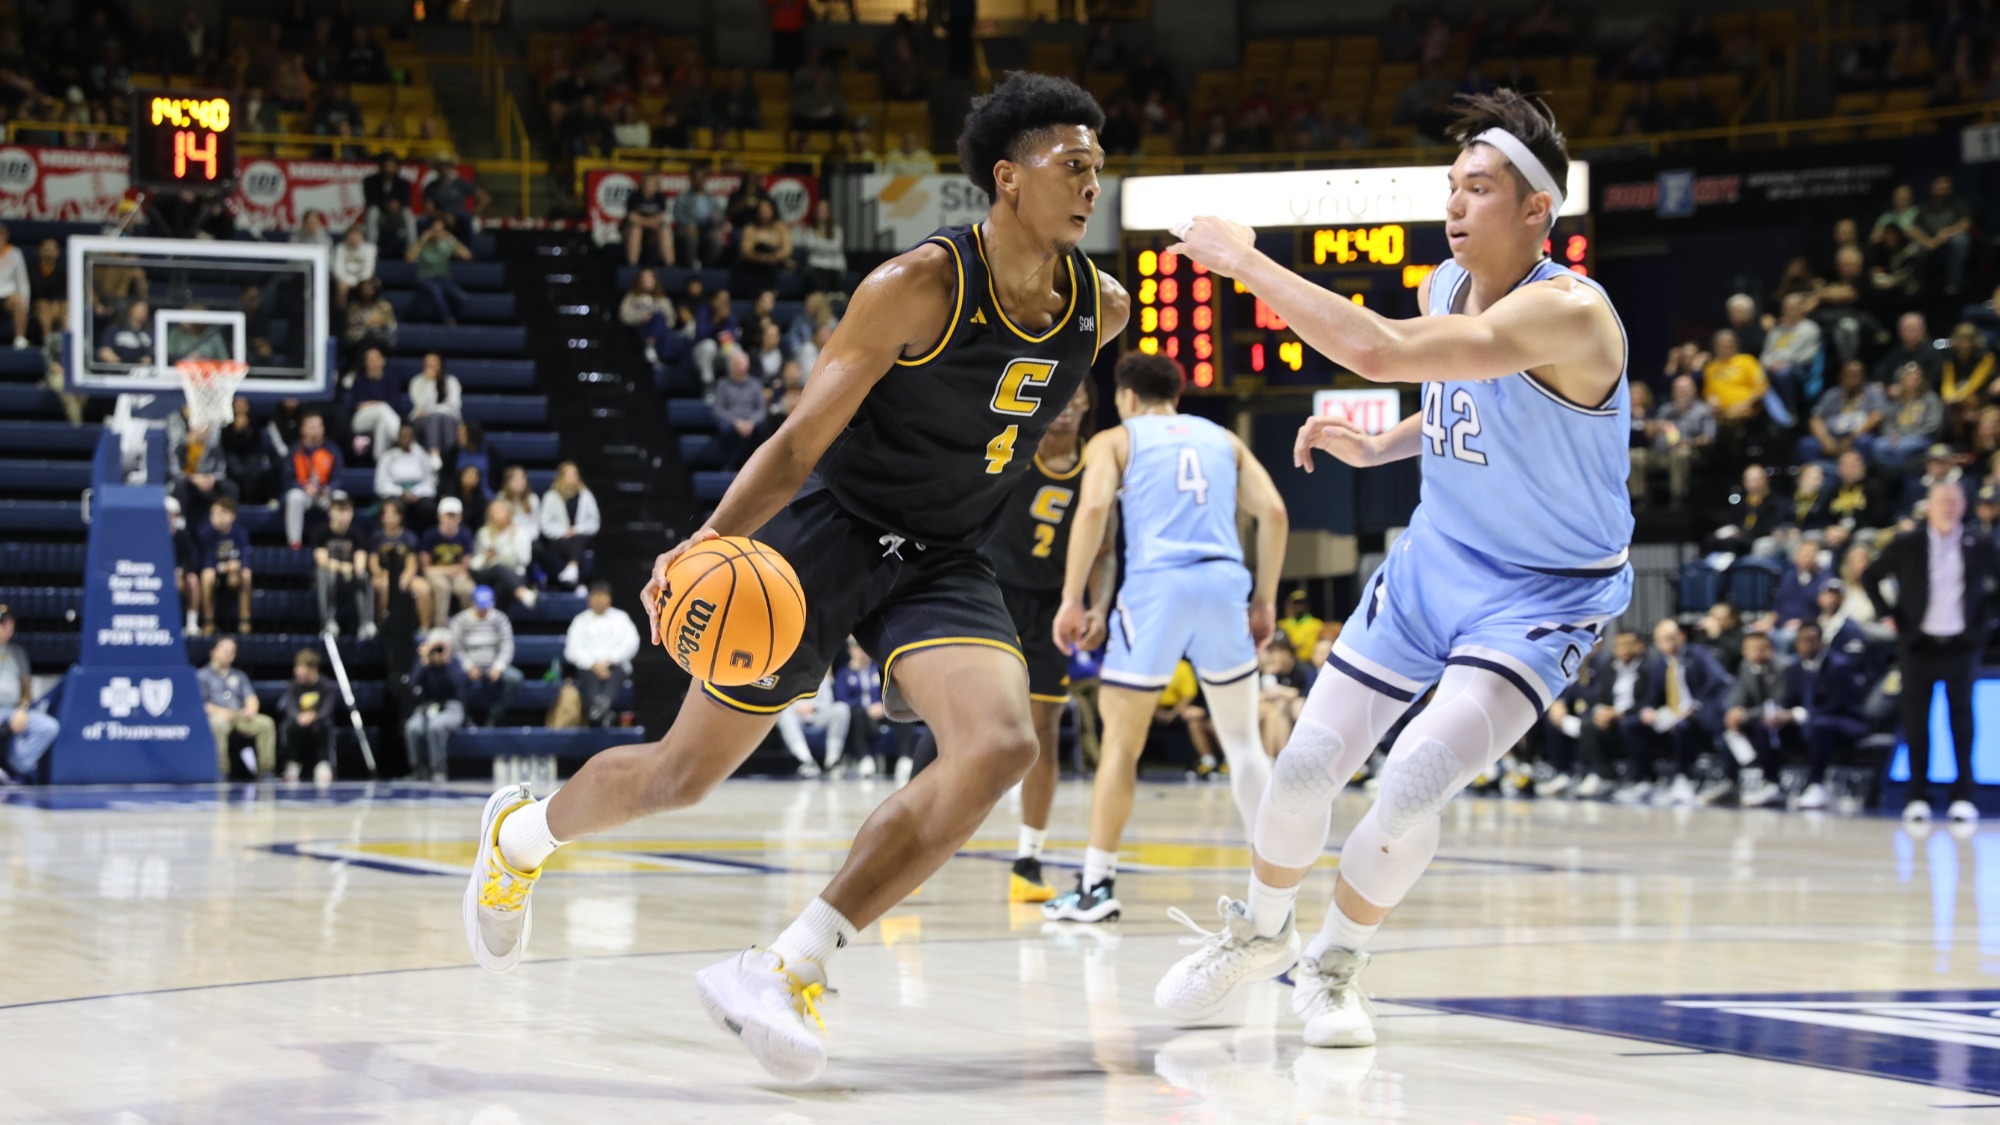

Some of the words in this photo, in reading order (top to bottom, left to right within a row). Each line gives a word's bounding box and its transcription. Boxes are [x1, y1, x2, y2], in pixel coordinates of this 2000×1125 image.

[151, 97, 230, 132] 14:40
[174, 131, 217, 180] 14
[1314, 225, 1404, 265] 14:40
[989, 357, 1059, 417] C
[1422, 381, 1488, 466] 42
[984, 424, 1019, 474] 4
[1176, 447, 1210, 505] 4
[1029, 485, 1074, 524] C
[1031, 523, 1055, 558] 2
